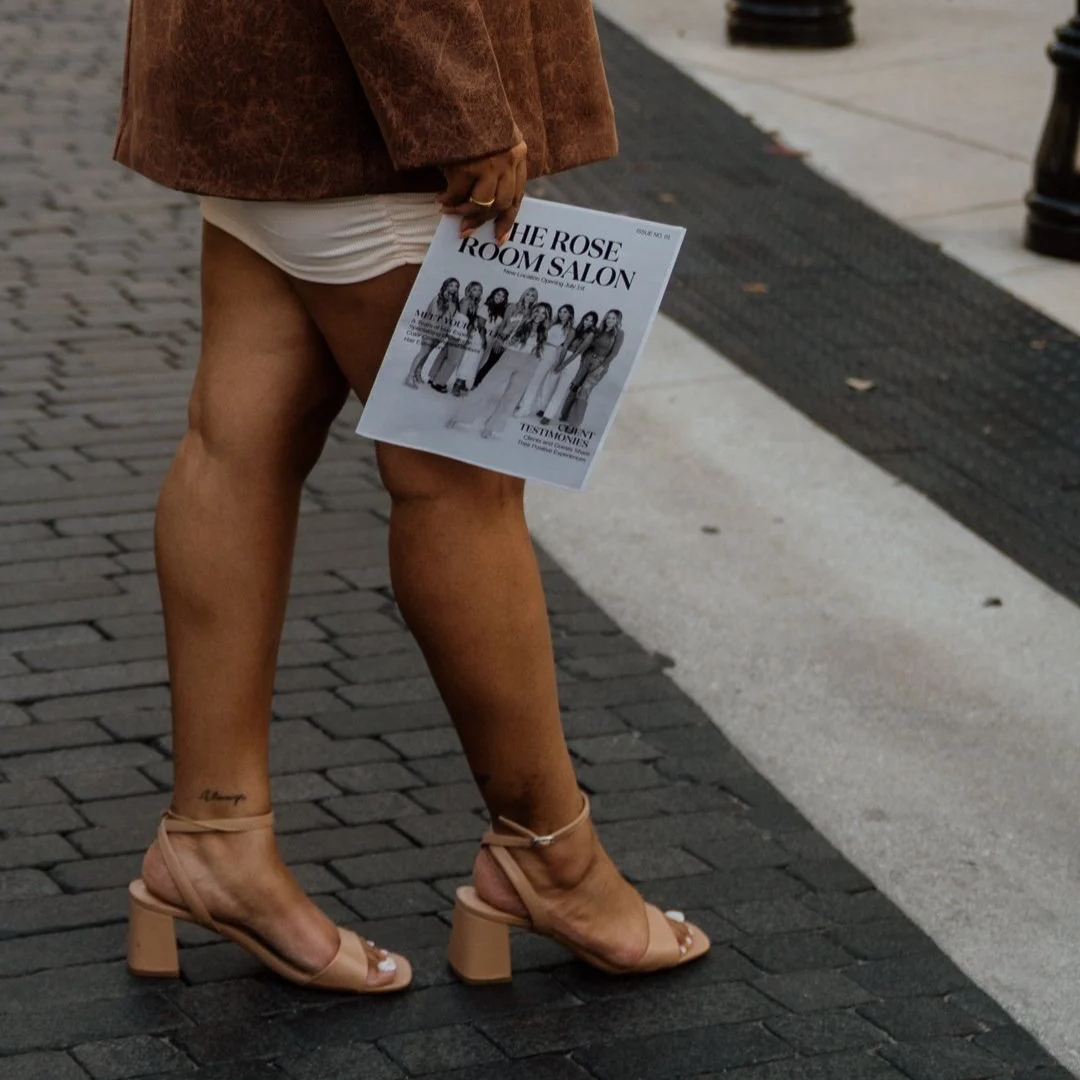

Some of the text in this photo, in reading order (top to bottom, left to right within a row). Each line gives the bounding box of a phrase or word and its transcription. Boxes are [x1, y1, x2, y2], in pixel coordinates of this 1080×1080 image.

[508, 222, 622, 263] HE ROSE
[458, 236, 636, 291] ROOM SALON
[520, 422, 590, 448] TESTIMONIES
[557, 424, 597, 440] CLIENT
